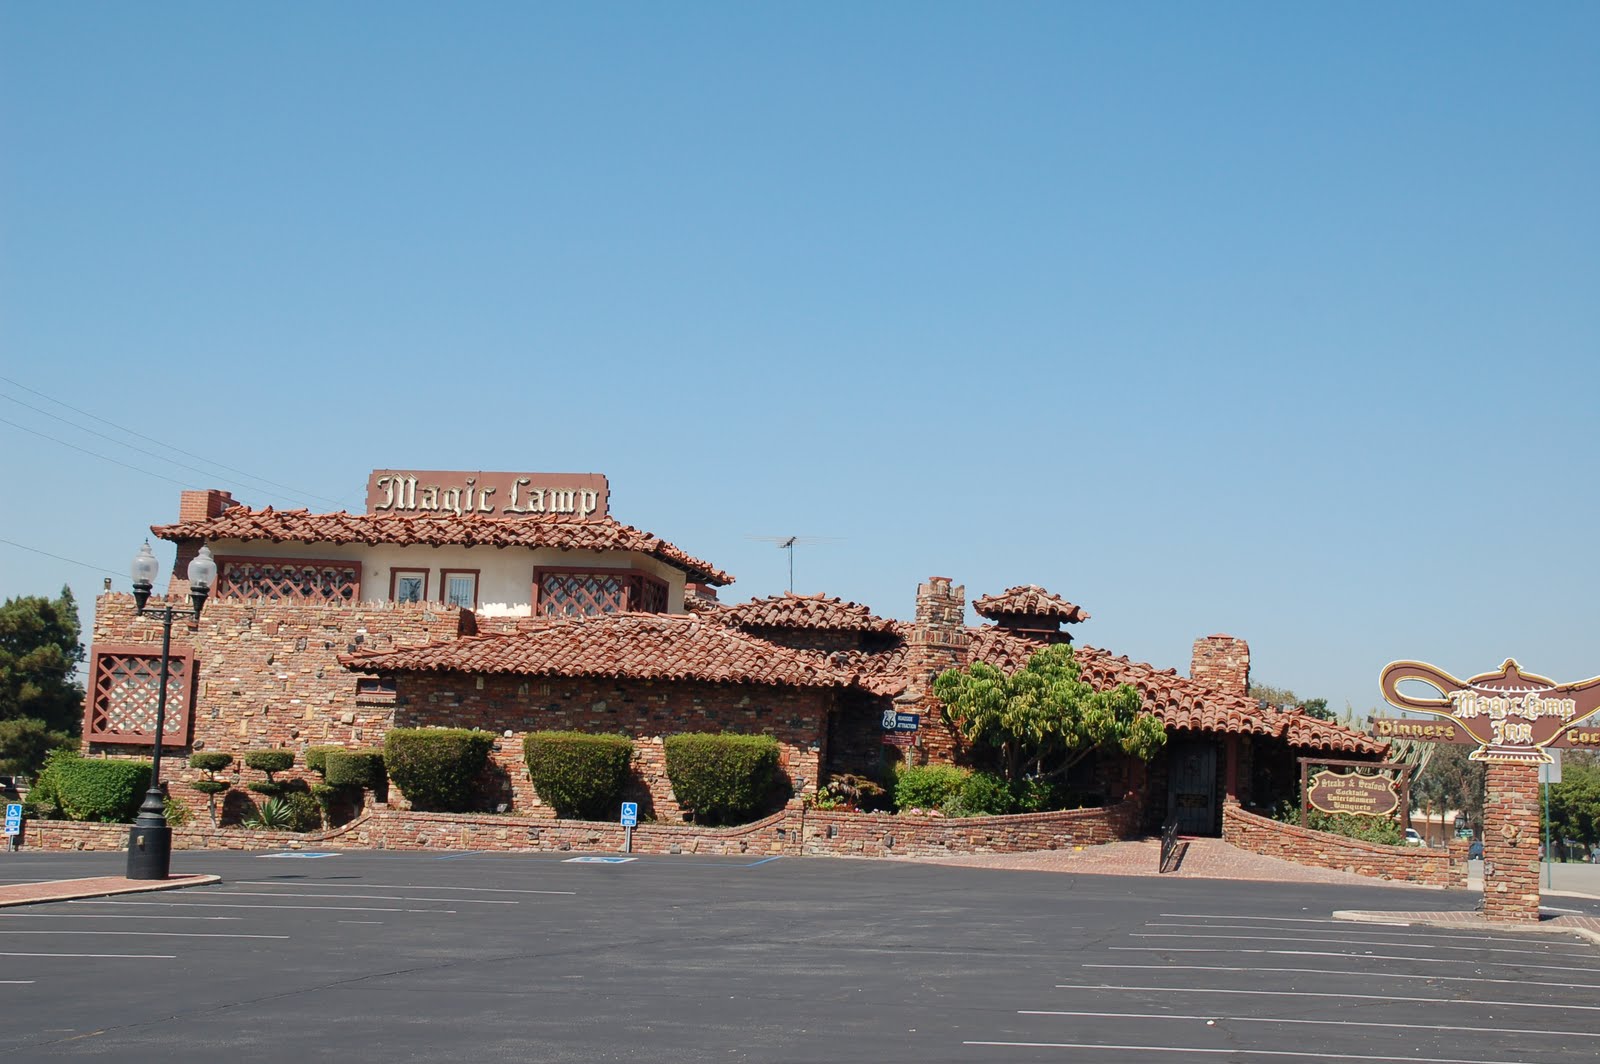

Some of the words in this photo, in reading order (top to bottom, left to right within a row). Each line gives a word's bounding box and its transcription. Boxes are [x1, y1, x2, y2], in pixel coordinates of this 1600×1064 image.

[374, 472, 497, 517] Magic
[503, 475, 600, 519] Lamp
[1448, 689, 1524, 720] Magic
[1522, 692, 1576, 722] Lamp
[884, 716, 895, 727] 66
[1377, 720, 1456, 738] Dinners
[1490, 719, 1534, 744] Inn
[1321, 779, 1346, 788] Steaks
[1348, 779, 1355, 788] &
[1358, 779, 1387, 792] Seafood
[1327, 794, 1377, 804] Entertainment
[1335, 789, 1369, 797] Cocktails
[1333, 801, 1371, 810] Banquets
